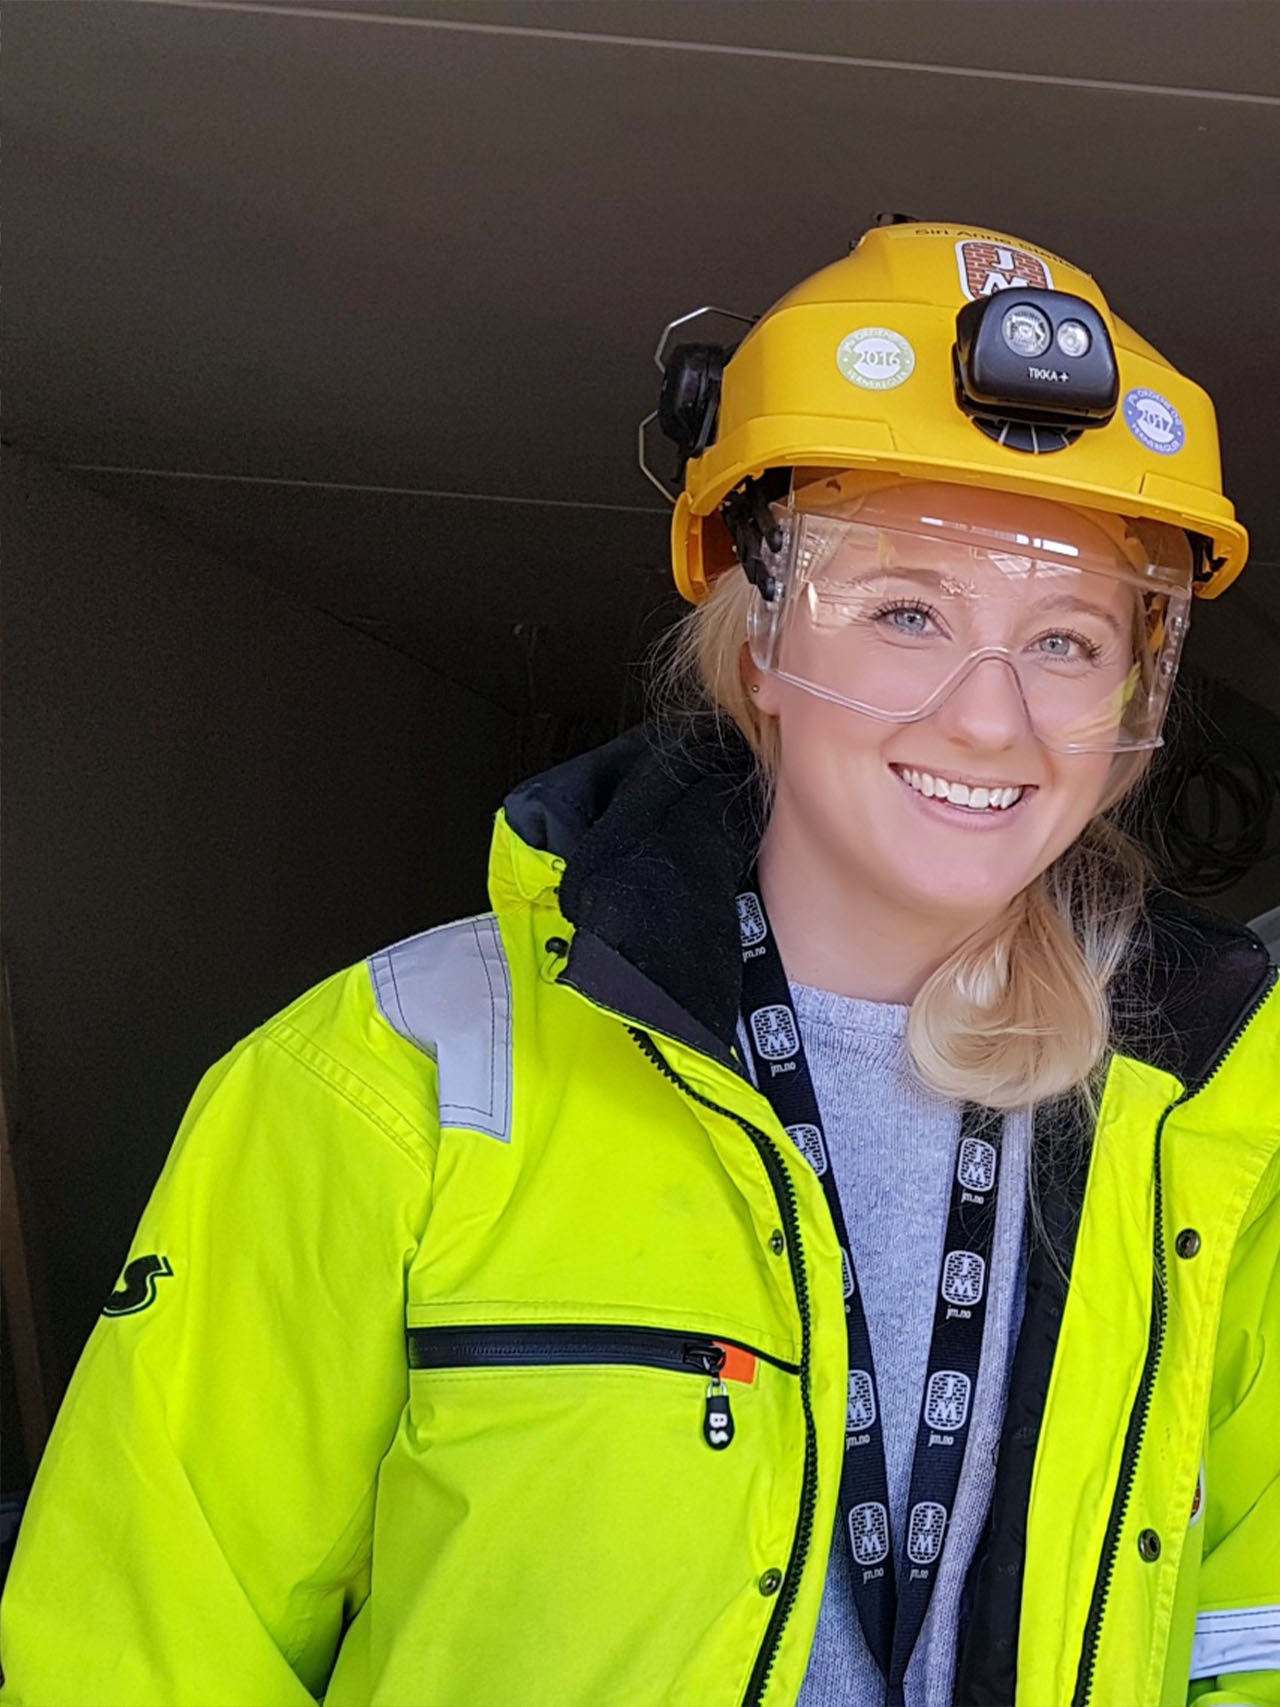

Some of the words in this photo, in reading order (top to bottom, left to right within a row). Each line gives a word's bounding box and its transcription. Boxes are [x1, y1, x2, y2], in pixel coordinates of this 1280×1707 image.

[856, 351, 901, 367] 2016
[770, 1061, 796, 1078] jm.no
[946, 1305, 972, 1320] jm.no
[928, 1430, 955, 1447] jm.no
[862, 1567, 885, 1585] jm.no
